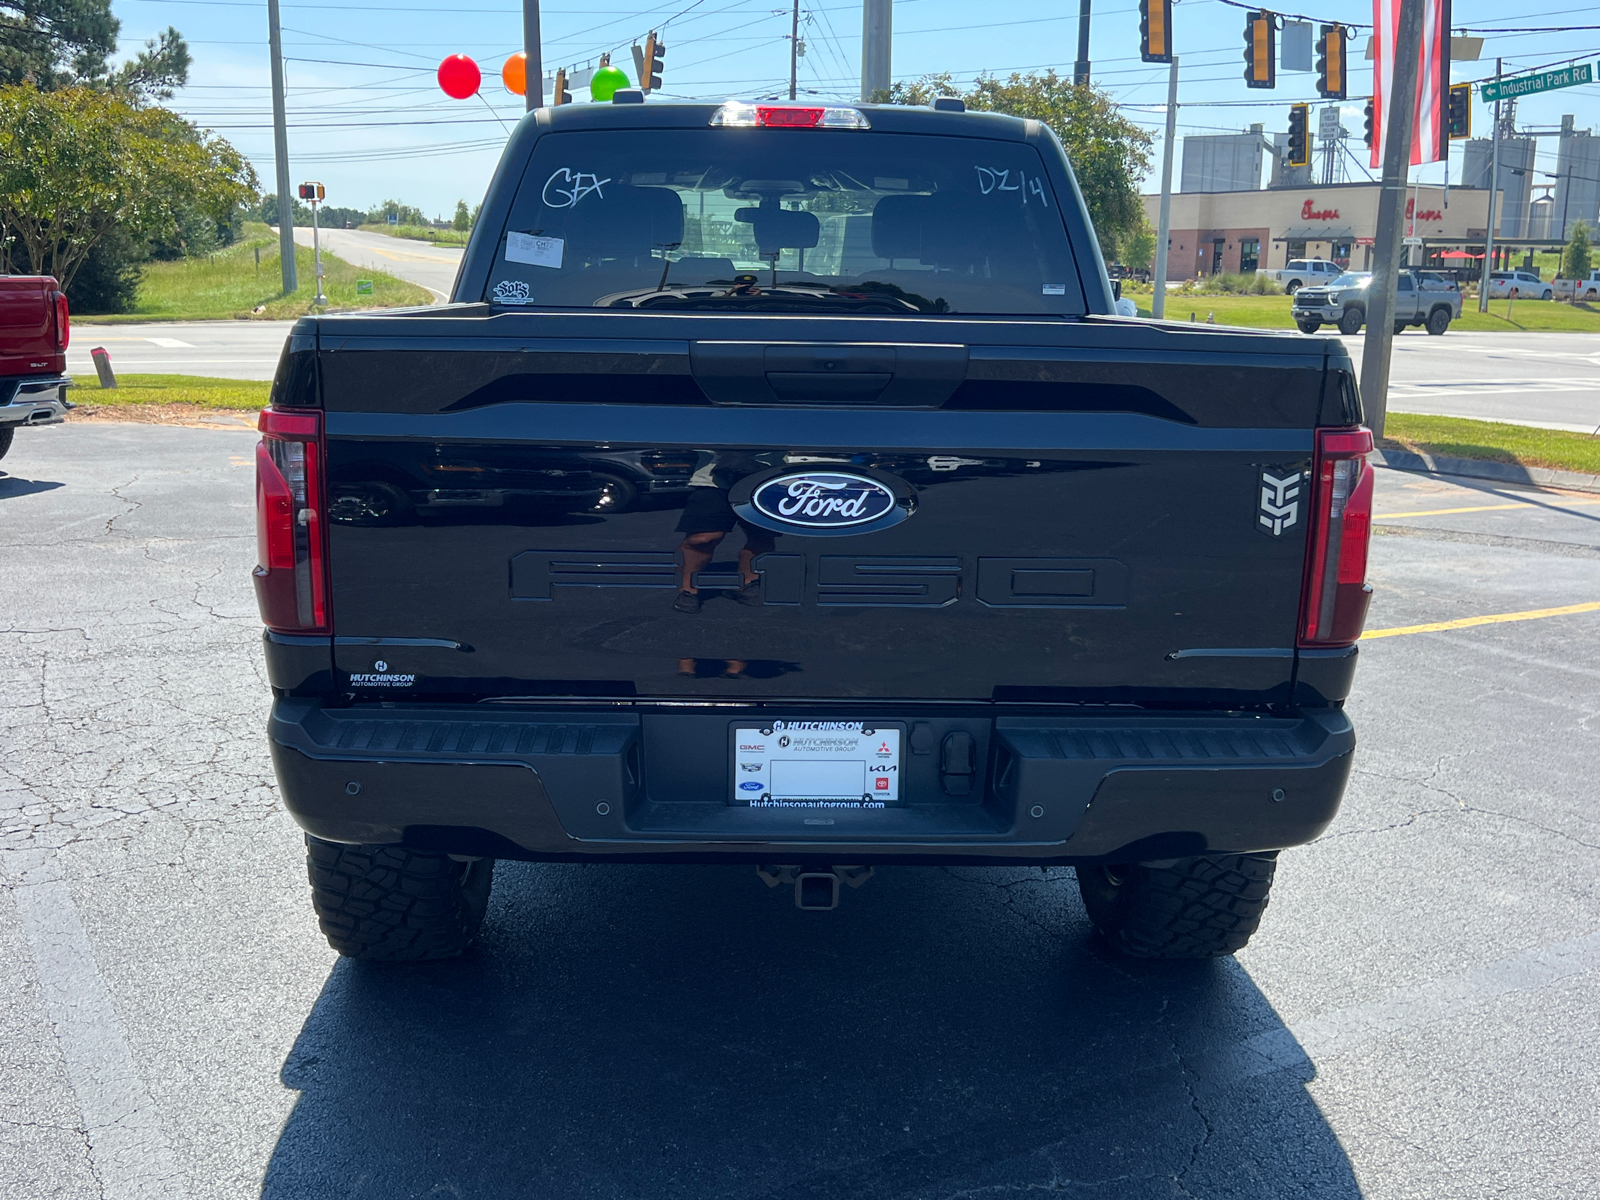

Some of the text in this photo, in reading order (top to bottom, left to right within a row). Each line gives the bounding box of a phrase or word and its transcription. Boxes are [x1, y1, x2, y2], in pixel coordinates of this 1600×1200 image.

[1500, 67, 1587, 96] Industrial Park Rd
[778, 480, 869, 517] Ford
[509, 550, 1128, 608] F-150
[350, 674, 415, 682] HUTCHINSON
[787, 721, 864, 731] HUTCHINSON
[793, 738, 859, 747] HUTCHINSON
[743, 782, 760, 790] Ford
[750, 800, 885, 808] Hutchinsonautogroup.com
